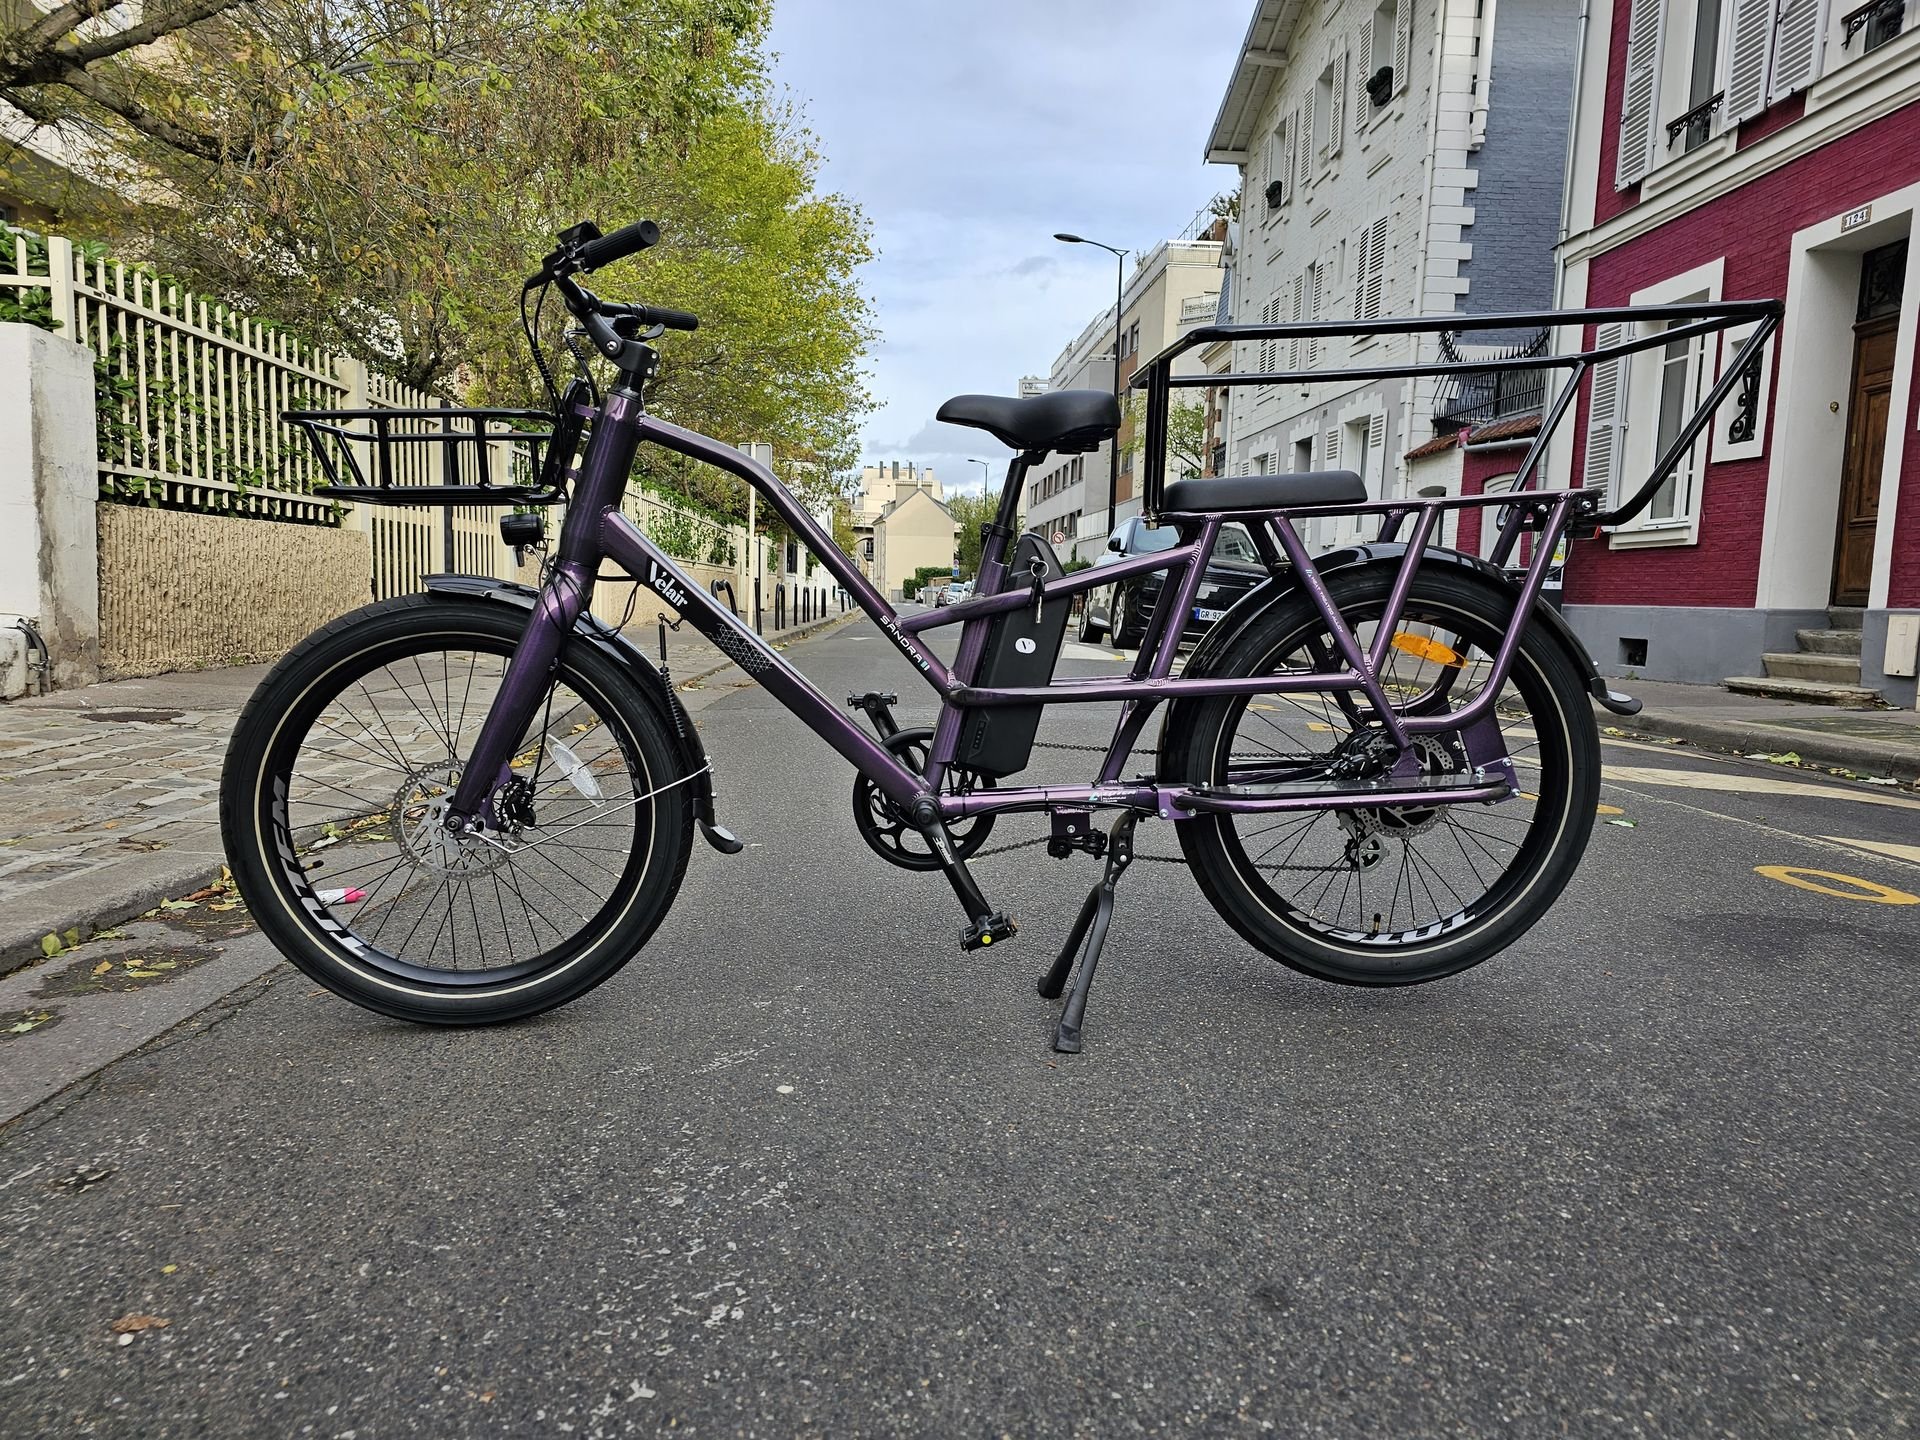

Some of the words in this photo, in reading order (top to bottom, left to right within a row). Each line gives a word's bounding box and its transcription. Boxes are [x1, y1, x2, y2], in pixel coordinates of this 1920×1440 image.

[1848, 211, 1865, 225] 124
[1200, 610, 1226, 620] GR-92
[880, 615, 923, 663] SANDRA
